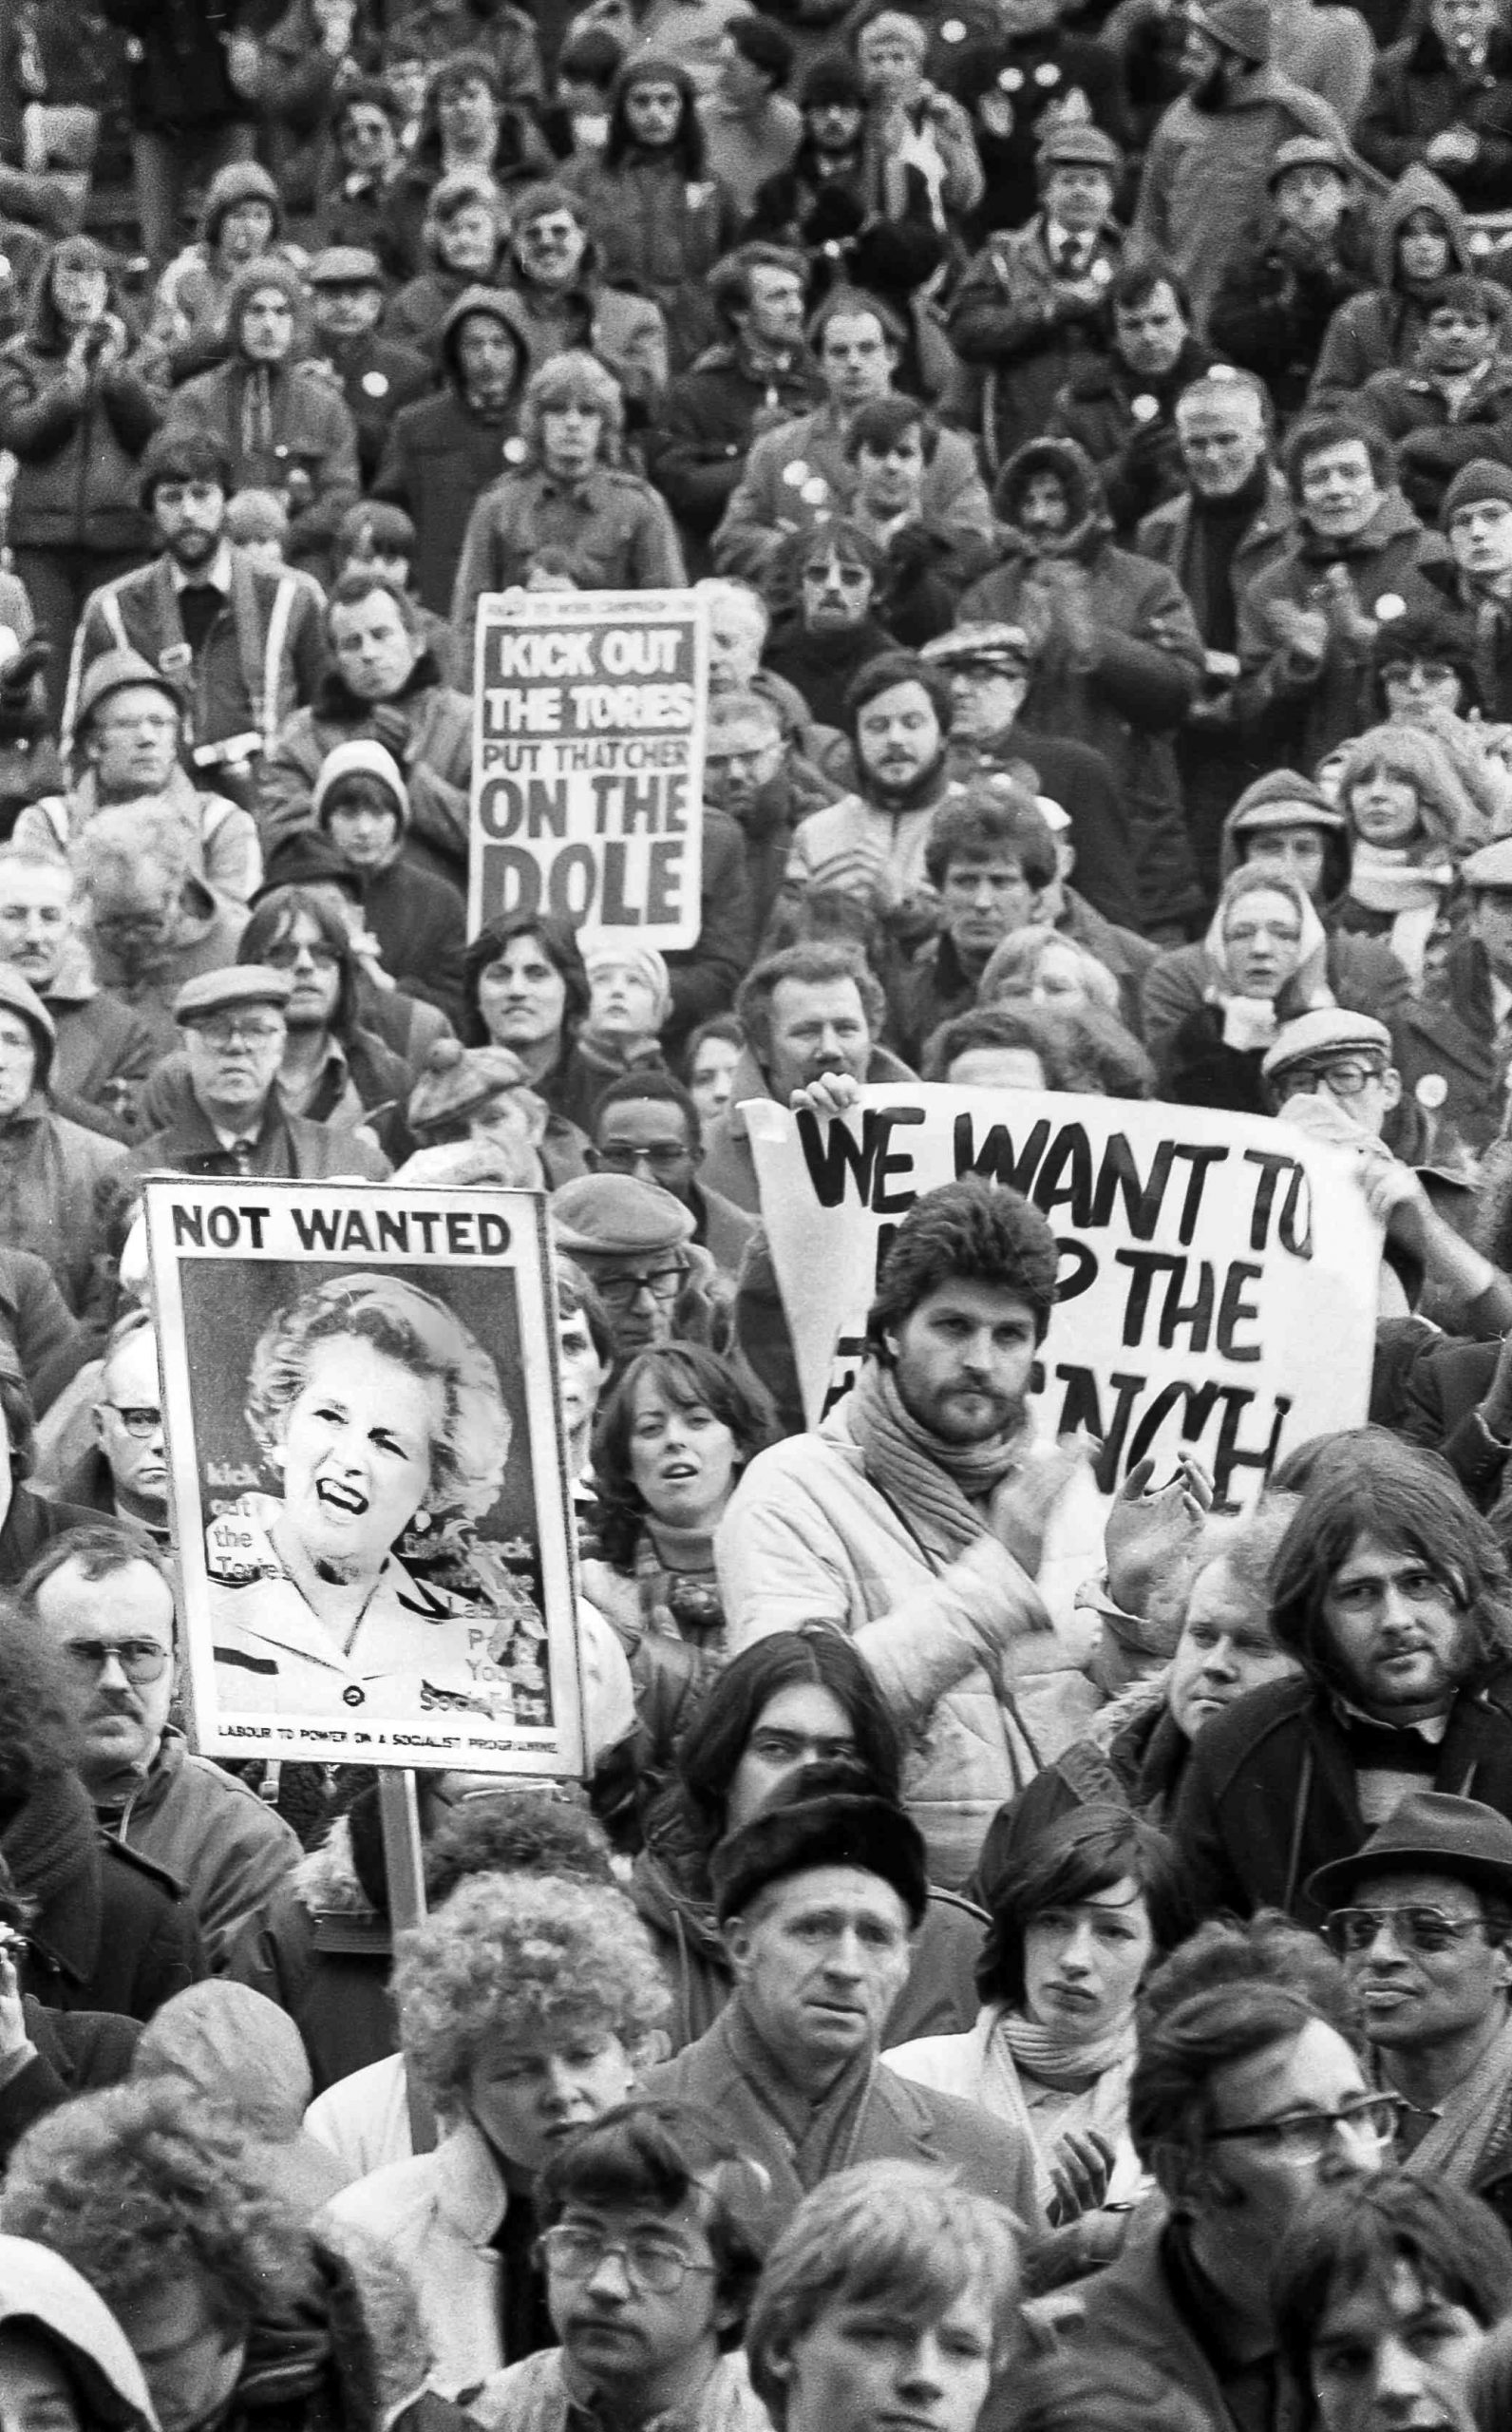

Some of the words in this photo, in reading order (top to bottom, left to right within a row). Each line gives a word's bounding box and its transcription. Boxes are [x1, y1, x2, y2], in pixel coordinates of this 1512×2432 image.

[501, 632, 595, 677] KICK
[601, 629, 683, 674] OUT
[484, 687, 562, 732] THE
[570, 682, 694, 730] TORIES
[482, 744, 540, 772] PUT
[555, 740, 690, 771] THATCHER
[480, 777, 568, 839] ON
[591, 773, 690, 835] THE
[481, 840, 684, 929] DOLE
[796, 1107, 926, 1214] WE
[953, 1111, 1229, 1246] WANT
[1244, 1149, 1314, 1262] TO
[171, 1204, 272, 1249] NOT
[291, 1207, 512, 1256] WANTED
[1115, 1247, 1264, 1362] THE
[213, 1525, 253, 1548] the
[218, 1725, 272, 1739] LABOUR
[276, 1728, 294, 1739] TO
[300, 1729, 348, 1743] POWER
[392, 1734, 461, 1749] SOCIALIST
